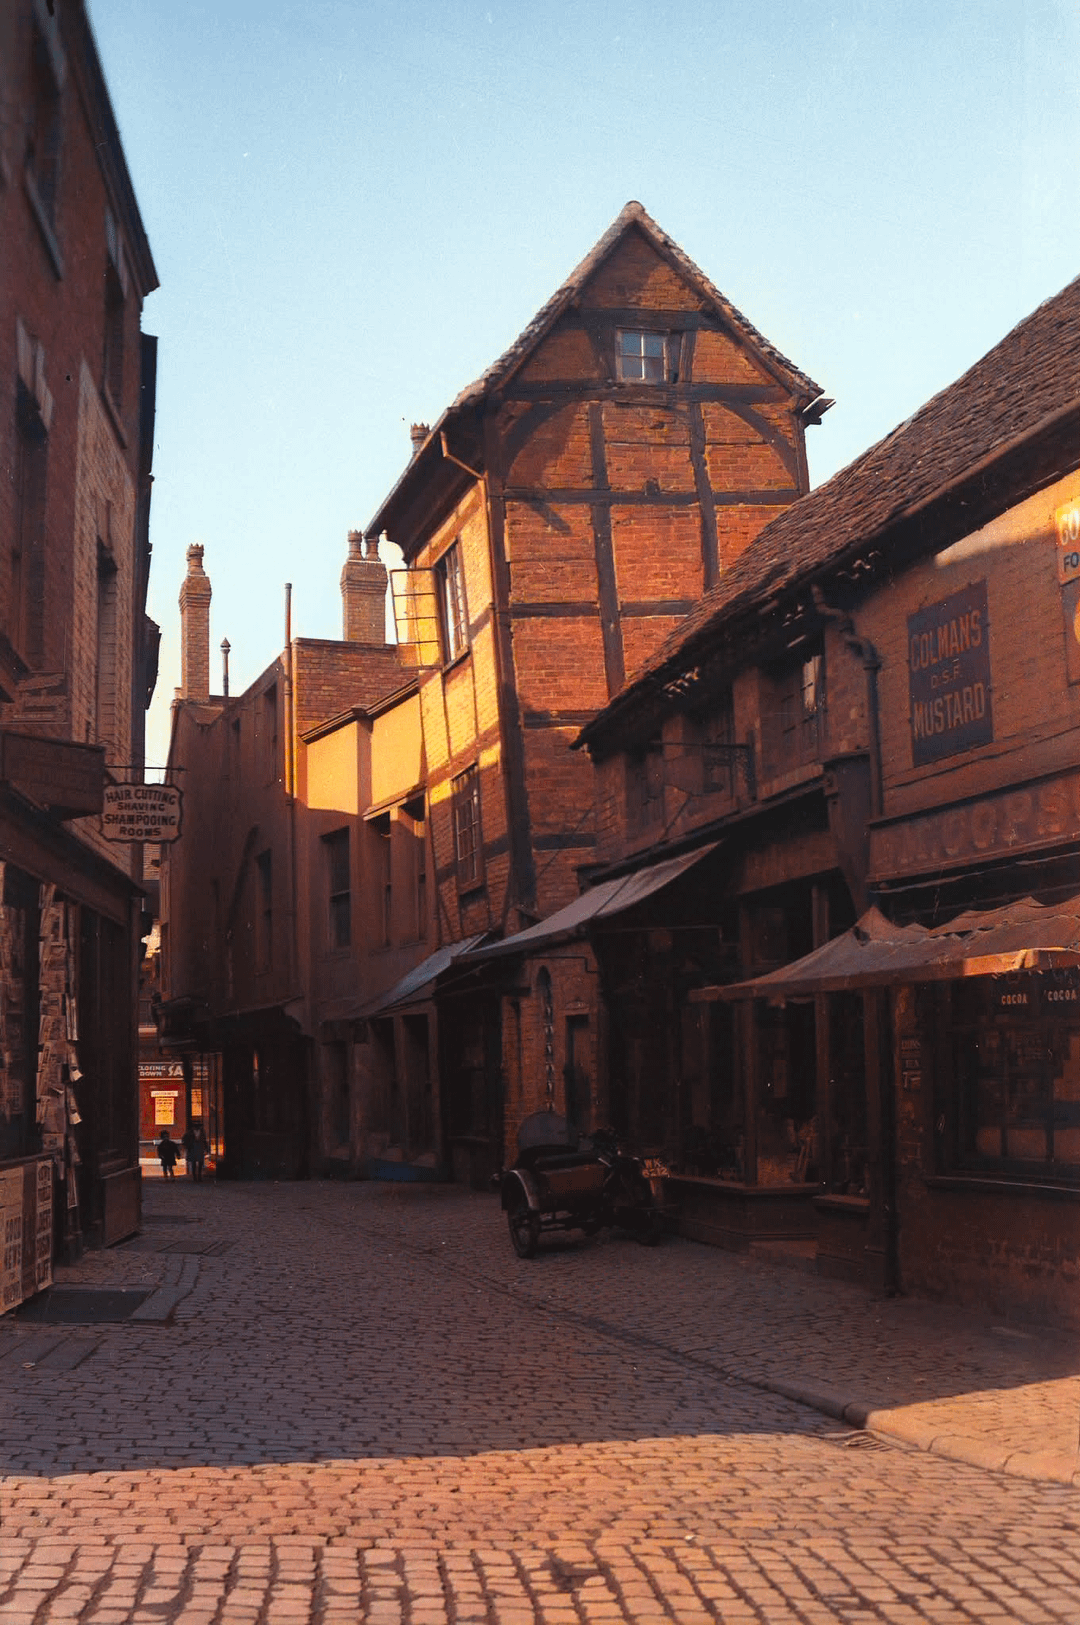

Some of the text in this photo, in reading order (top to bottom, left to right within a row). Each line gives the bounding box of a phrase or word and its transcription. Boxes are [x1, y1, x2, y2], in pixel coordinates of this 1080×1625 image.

[914, 682, 985, 741] MUSTARD
[105, 789, 177, 805] HAIR CUTTING
[117, 802, 165, 811] SHAVING
[104, 814, 177, 826] SHAMPOOING
[119, 826, 161, 836] ROOMS
[1001, 992, 1028, 1006] COCOA
[1047, 989, 1077, 1001] COCOA
